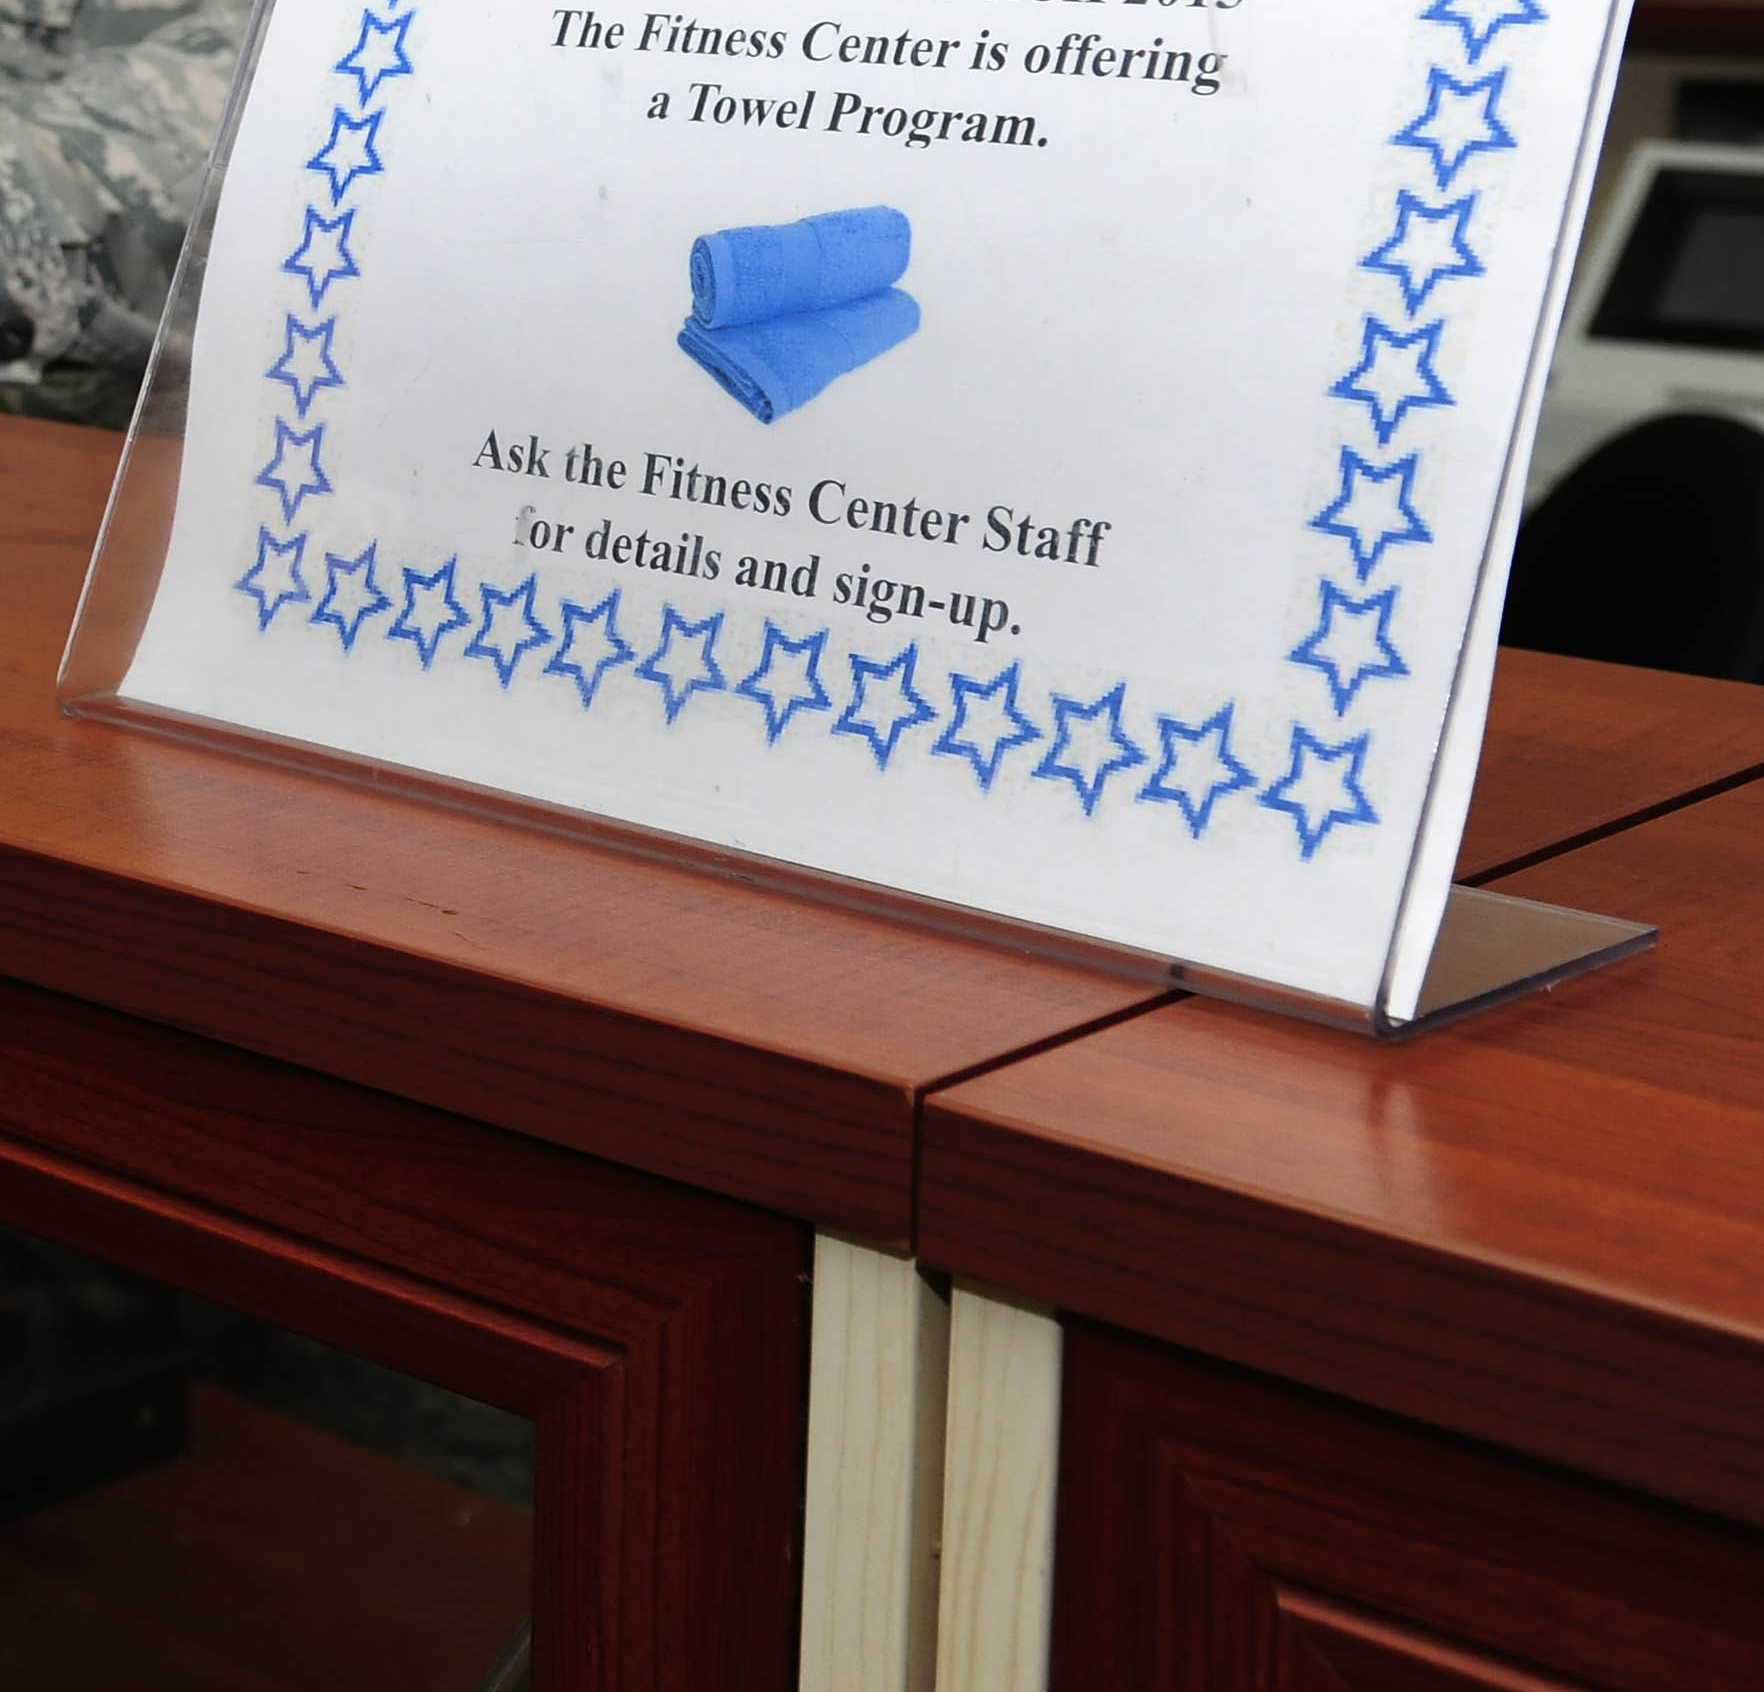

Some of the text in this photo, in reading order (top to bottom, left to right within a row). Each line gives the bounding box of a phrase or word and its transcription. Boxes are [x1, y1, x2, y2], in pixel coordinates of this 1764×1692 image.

[552, 8, 1227, 97] The Fitness Center is offering
[645, 82, 1049, 150] a Towel Program.
[470, 428, 1113, 569] Ask the Fitness Center Staff
[583, 517, 723, 582] details
[733, 553, 822, 599] and
[831, 562, 1022, 639] sign-up.
